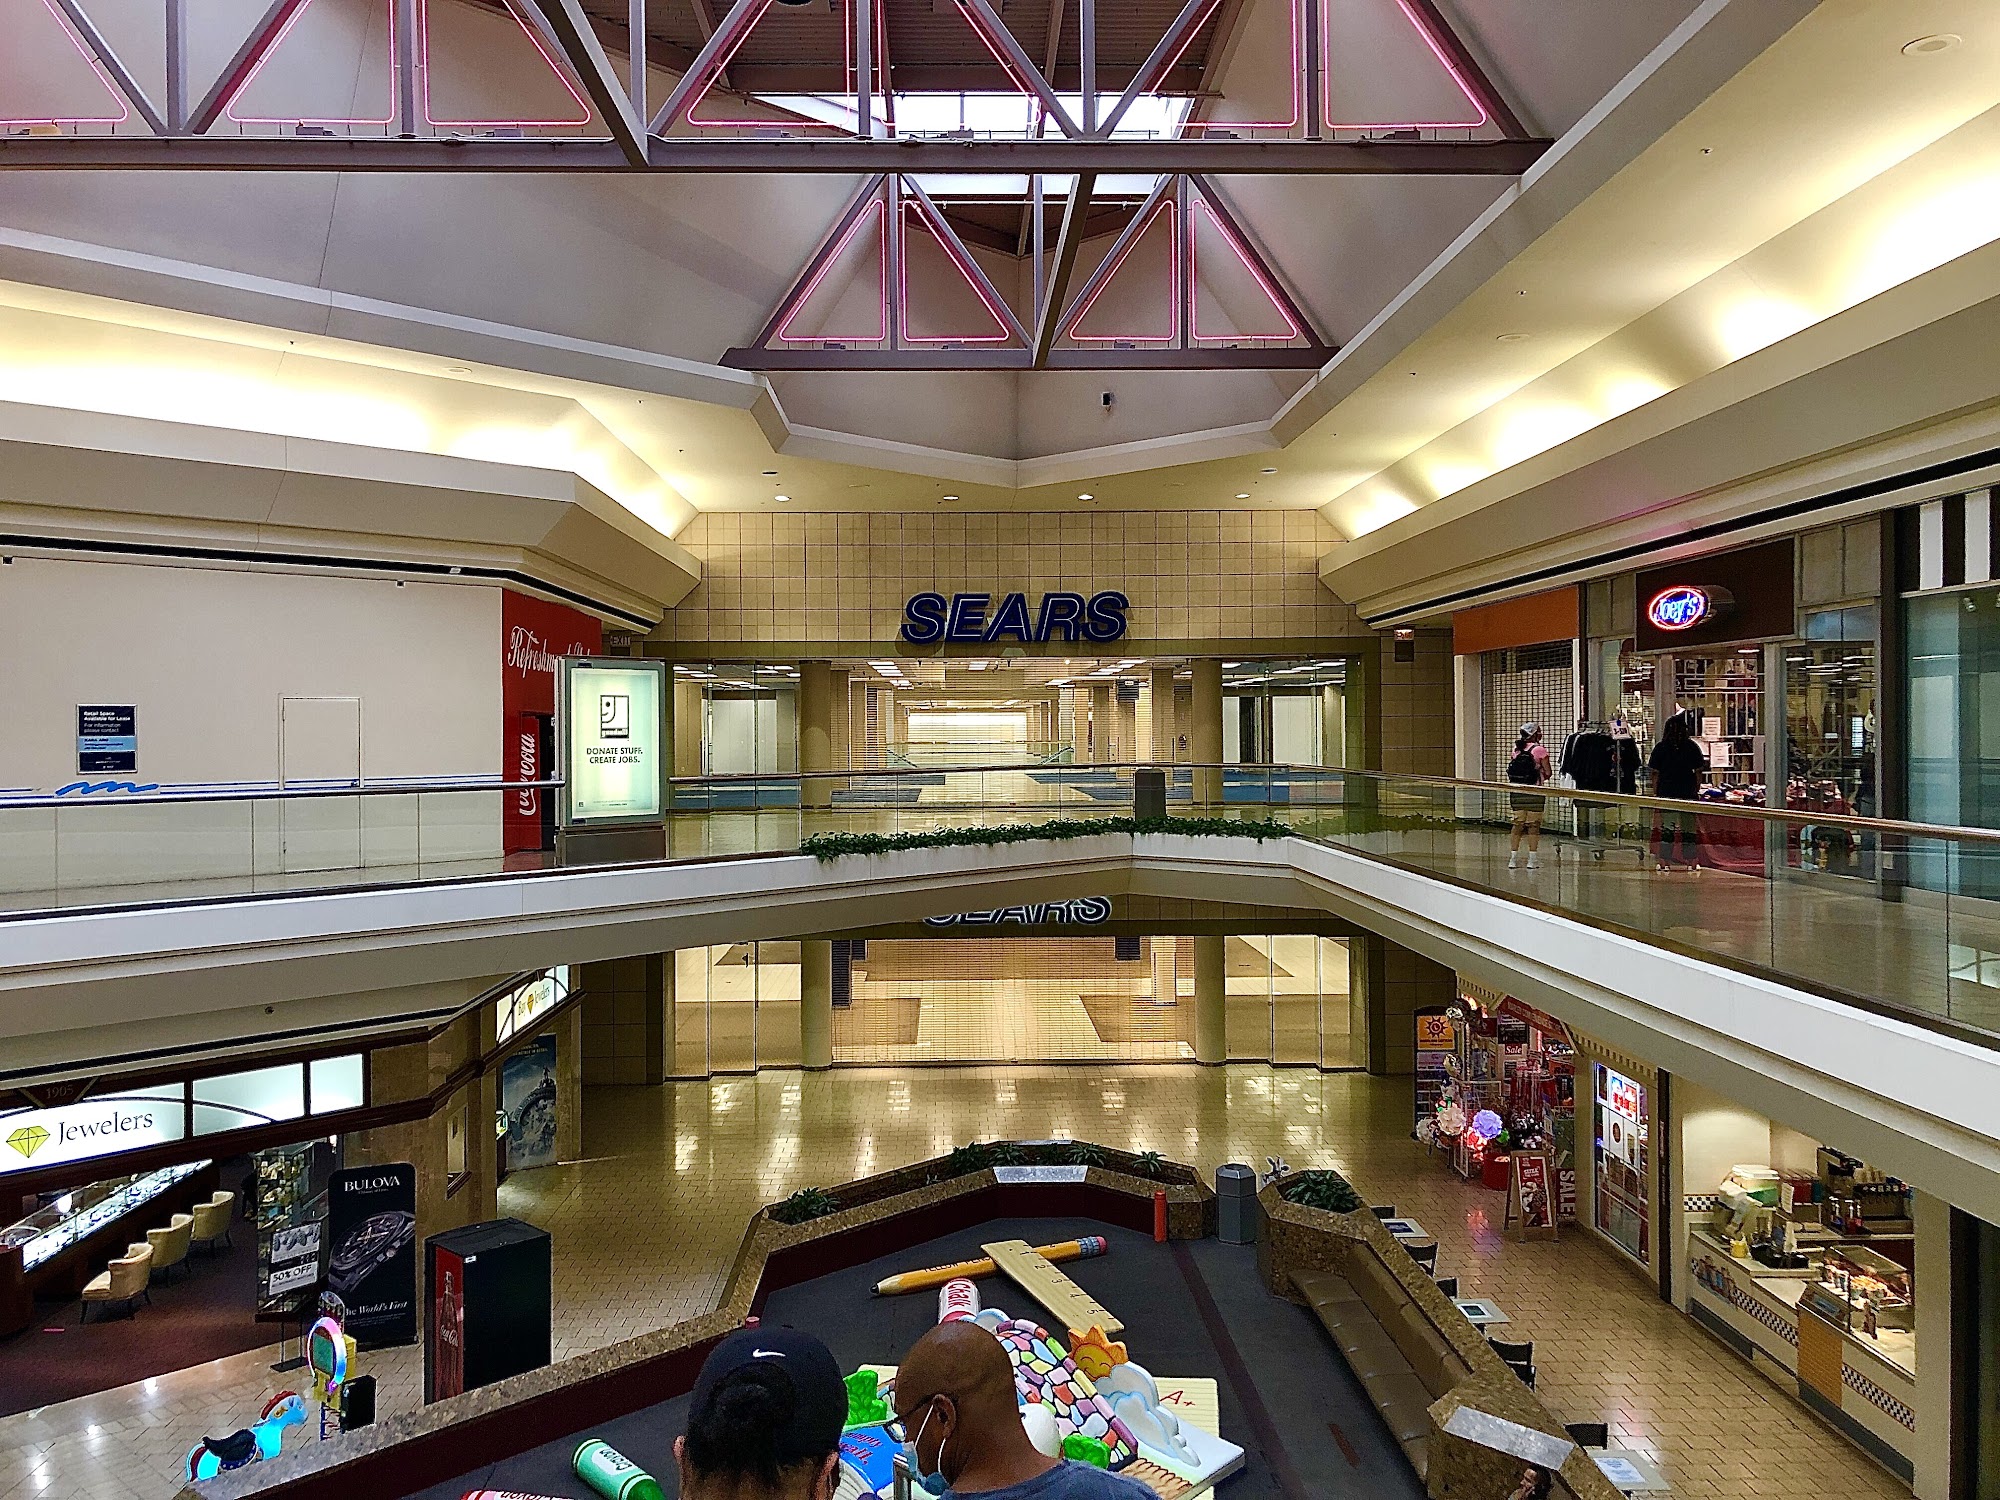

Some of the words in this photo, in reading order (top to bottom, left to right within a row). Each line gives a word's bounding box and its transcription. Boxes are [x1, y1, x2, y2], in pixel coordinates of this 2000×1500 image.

[900, 592, 1130, 644] SEARS
[586, 747, 618, 755] DONATE
[589, 756, 616, 764] CREATE
[618, 756, 640, 764] JOBS.
[1505, 1045, 1522, 1055] Sale
[46, 1084, 74, 1098] 1905
[58, 1111, 153, 1146] Jewelers
[344, 1176, 400, 1192] BULOVA
[1559, 1170, 1575, 1213] SALE
[272, 1270, 292, 1283] 50%
[293, 1264, 312, 1277] OFF
[947, 1282, 972, 1309] Chalk
